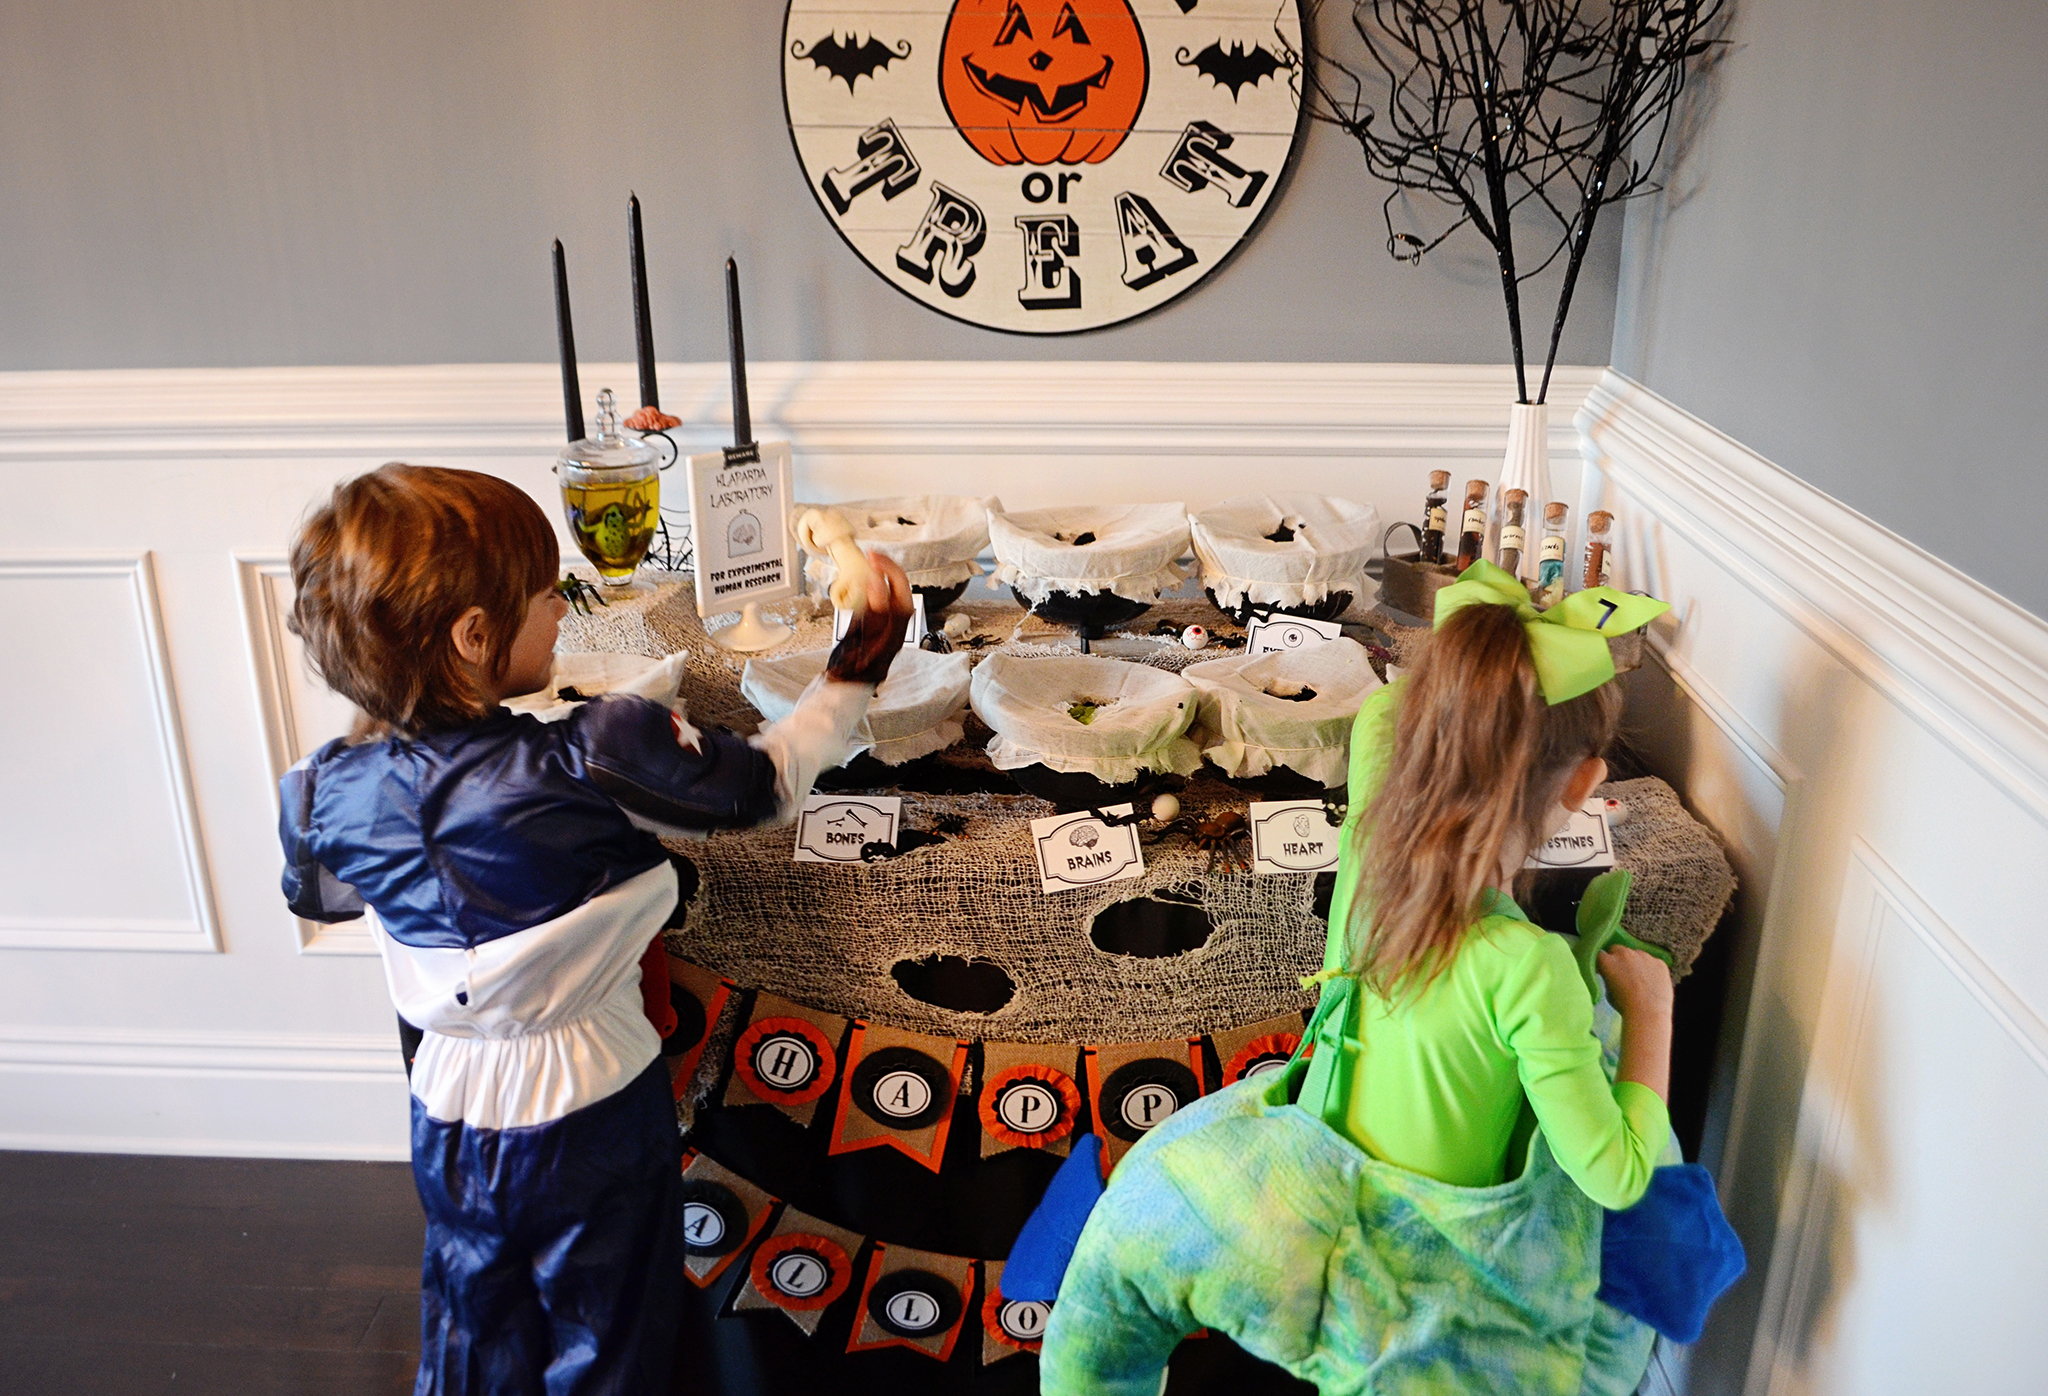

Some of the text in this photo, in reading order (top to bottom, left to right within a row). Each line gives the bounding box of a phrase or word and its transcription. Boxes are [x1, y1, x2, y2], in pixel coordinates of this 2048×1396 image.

[1022, 171, 1082, 203] or
[822, 118, 1268, 310] TREAT
[710, 484, 773, 508] LABORATORY
[711, 559, 783, 582] FOR EXPERIMENTAL
[715, 573, 781, 595] HUMAN RESEARCH
[826, 832, 865, 845] BONES
[1283, 842, 1323, 856] HEART
[1542, 835, 1594, 850] ESTINES
[1067, 851, 1112, 870] BRAINS
